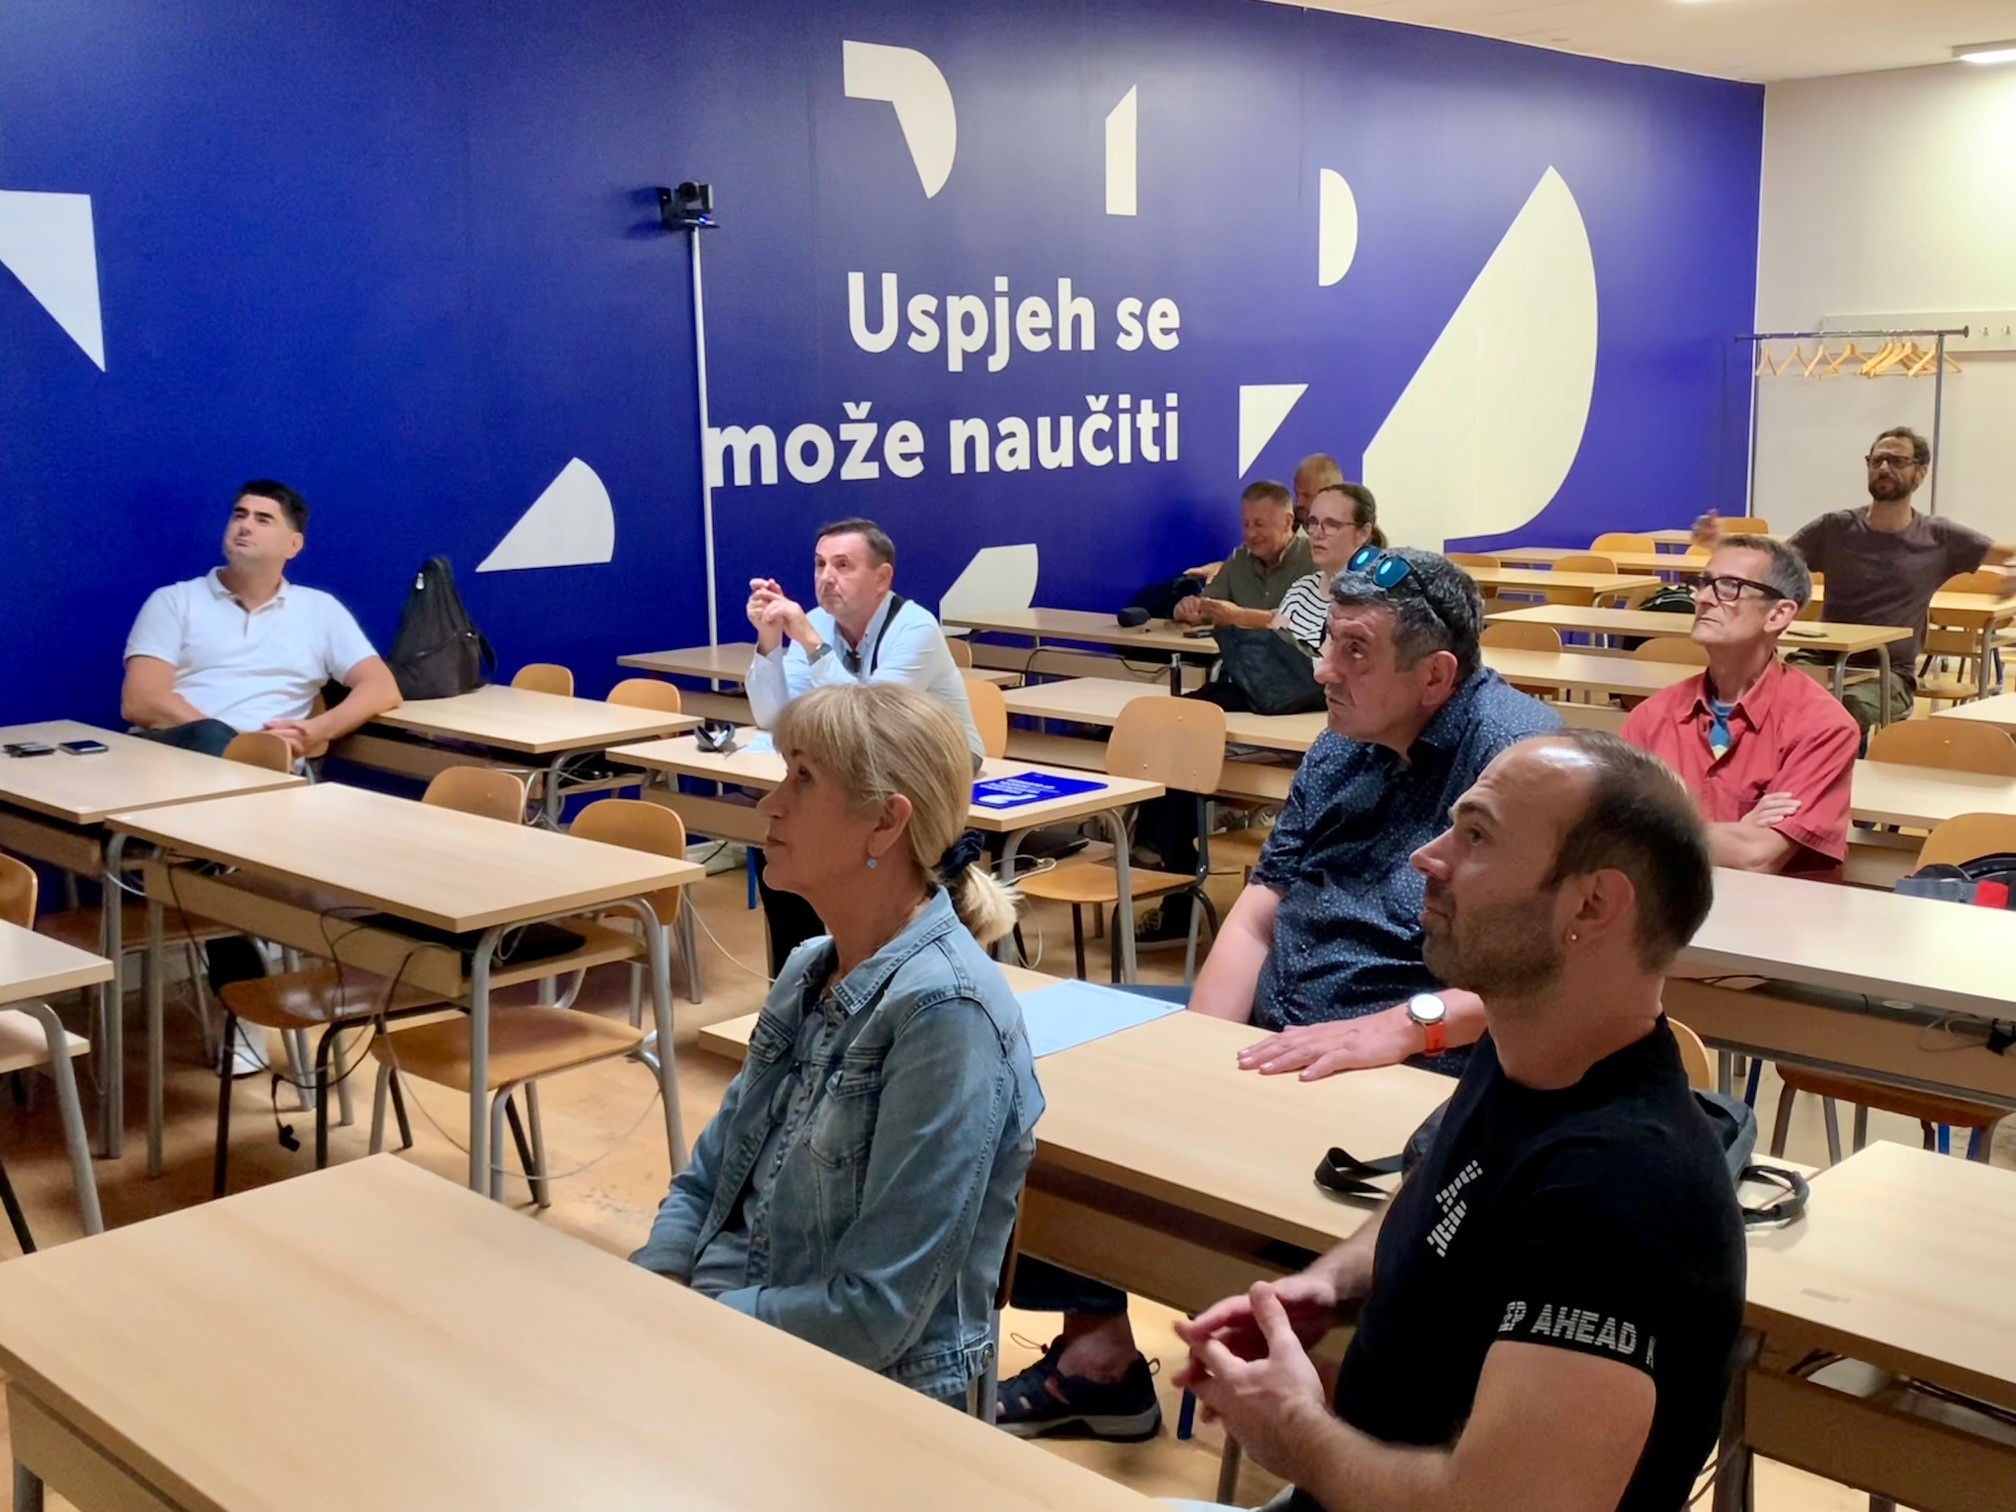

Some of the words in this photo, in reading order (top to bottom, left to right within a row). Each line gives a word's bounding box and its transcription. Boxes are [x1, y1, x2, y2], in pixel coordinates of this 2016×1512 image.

[847, 271, 1096, 373] Uspjeh
[1115, 296, 1181, 352] se
[707, 401, 925, 488] može
[949, 392, 1179, 475] naučiti
[1530, 1304, 1637, 1355] AHEAD
